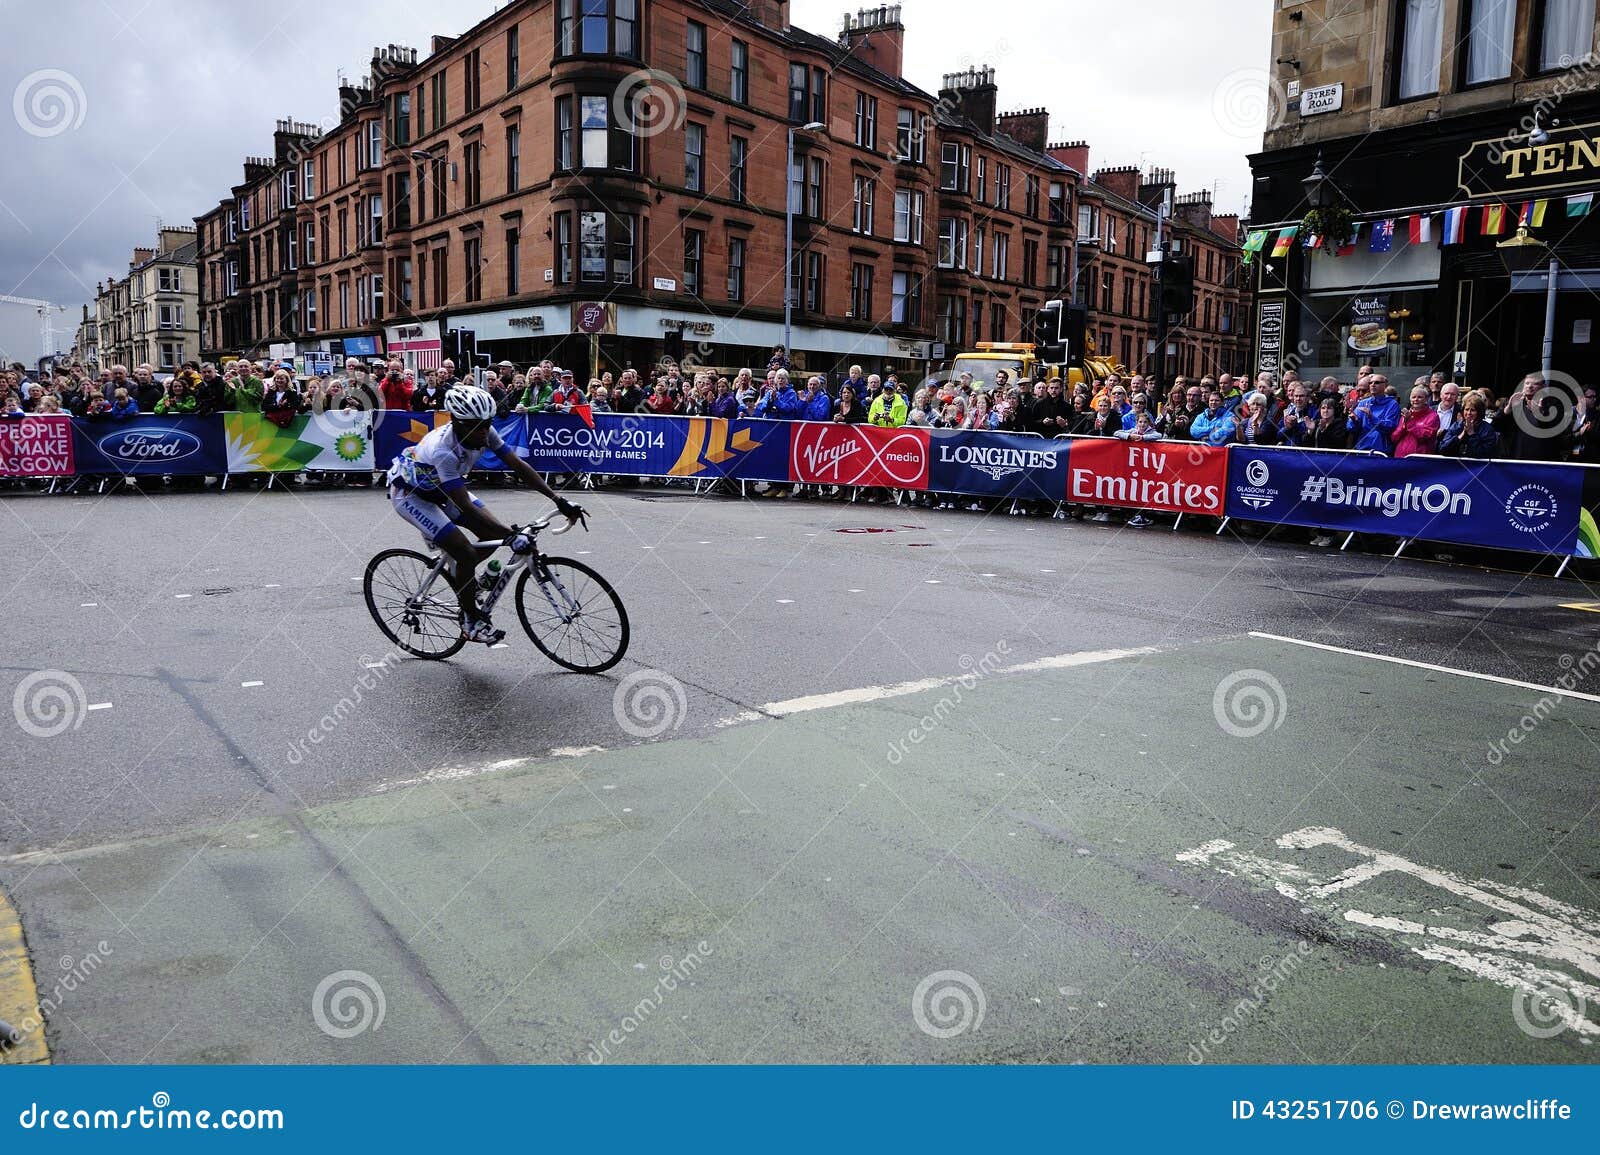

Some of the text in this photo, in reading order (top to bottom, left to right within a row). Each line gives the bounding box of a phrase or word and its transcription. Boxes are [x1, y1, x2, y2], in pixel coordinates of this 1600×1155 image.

[1307, 88, 1336, 100] BYRES
[1308, 98, 1333, 109] ROAD
[1501, 137, 1600, 179] TEN
[1353, 298, 1386, 315] Lunch
[320, 353, 334, 361] LET
[0, 423, 67, 439] PEOPLE
[620, 430, 665, 449] 2014
[15, 440, 69, 455] MAKE
[119, 432, 181, 457] Ford
[803, 427, 862, 479] Virgin
[533, 448, 648, 460] COMMONWEALTH GAMES
[885, 452, 920, 463] media
[940, 445, 1057, 470] LONGINES
[1128, 447, 1166, 475] Fly
[1072, 468, 1220, 510] Emirates
[1236, 486, 1265, 494] GLASGOW
[1300, 475, 1472, 518] #BringItOn
[1505, 483, 1550, 514] COMMONWEALTH
[402, 501, 439, 534] NAMIBIA
[1508, 518, 1550, 532] FEDERATION
